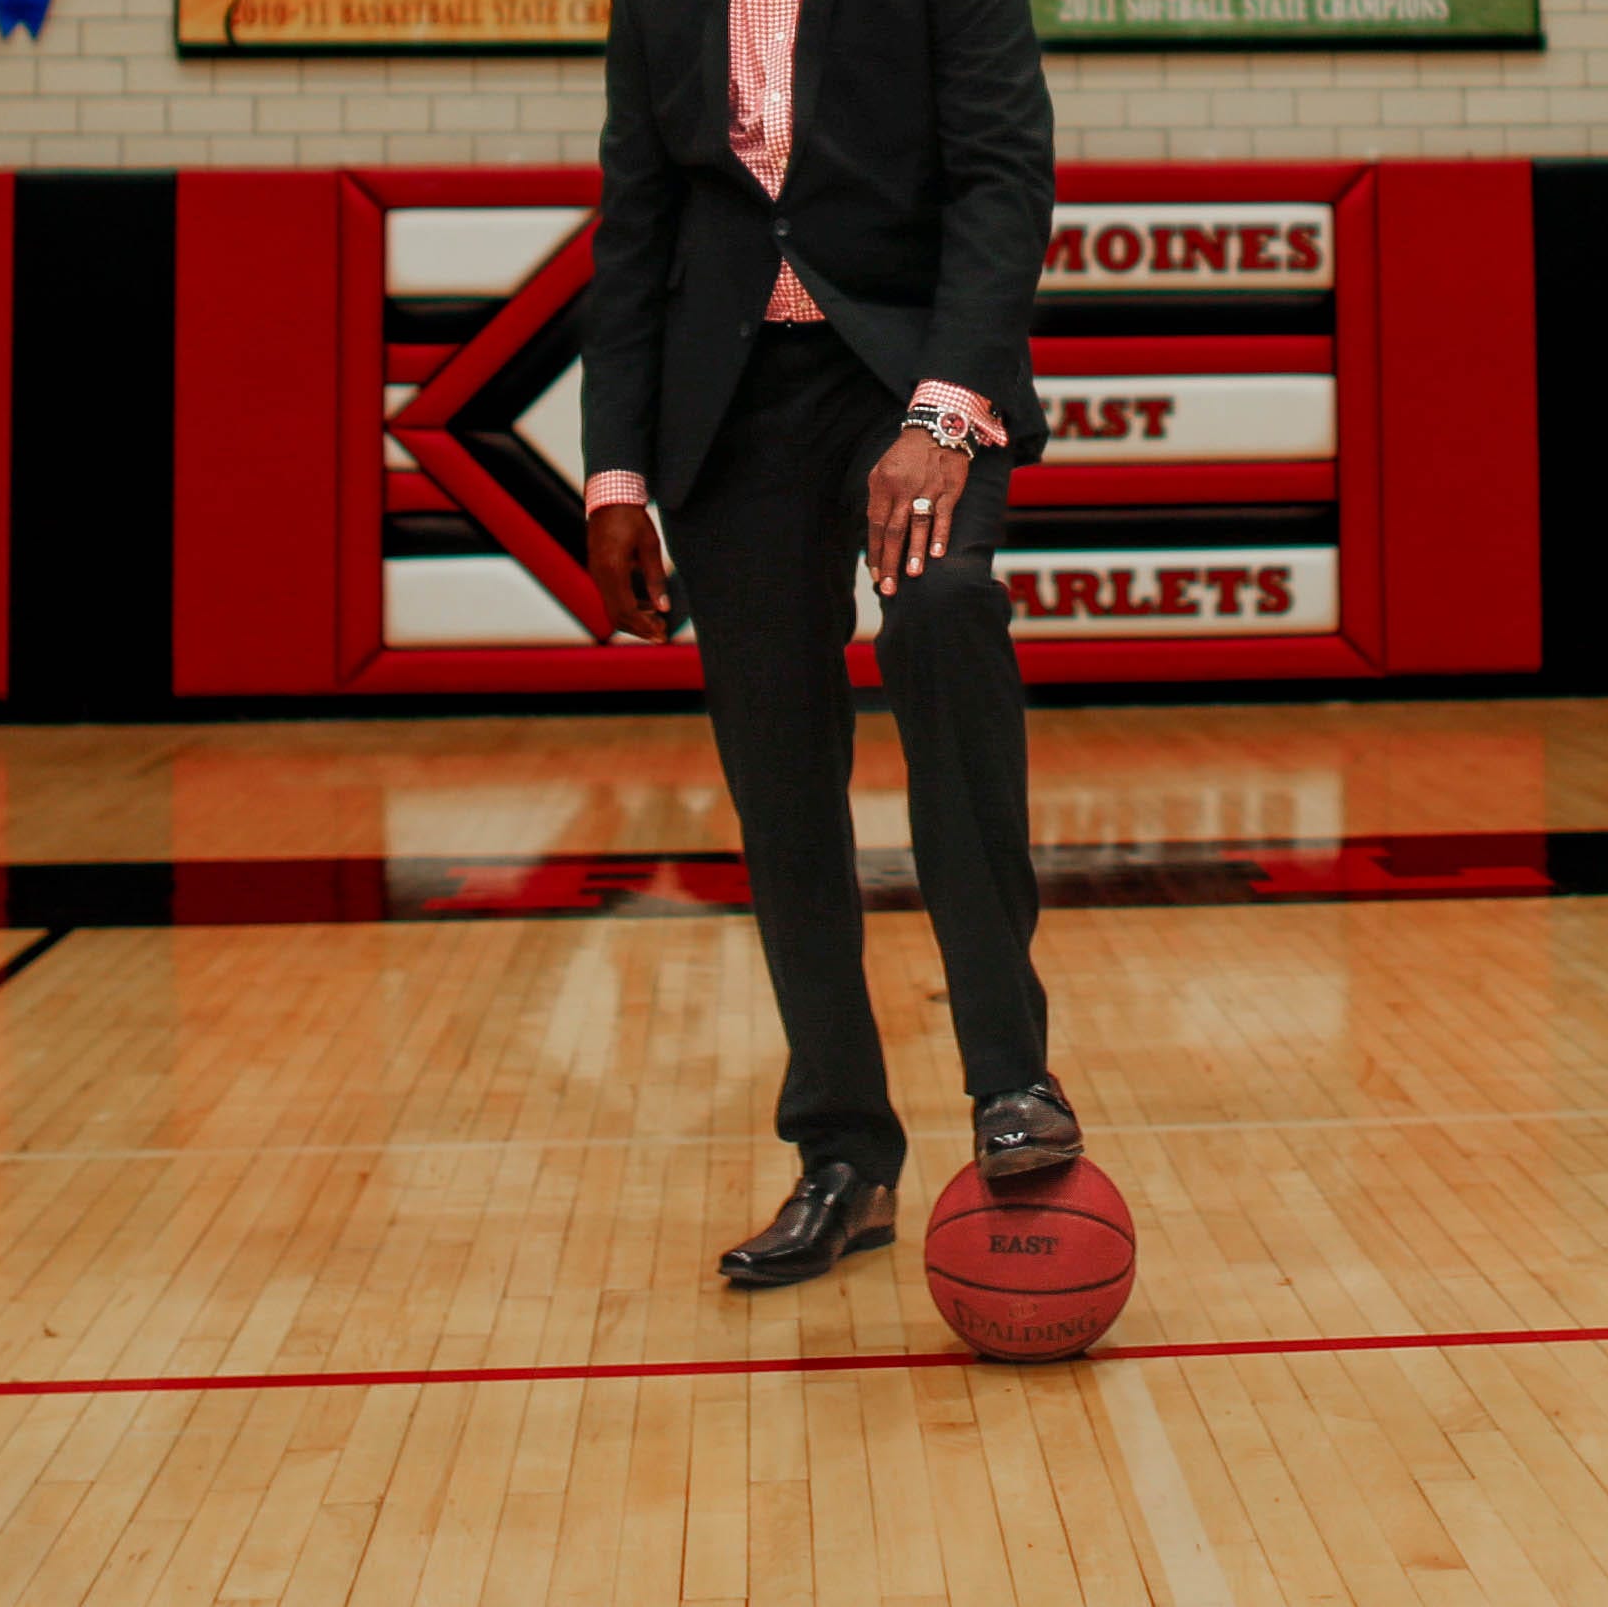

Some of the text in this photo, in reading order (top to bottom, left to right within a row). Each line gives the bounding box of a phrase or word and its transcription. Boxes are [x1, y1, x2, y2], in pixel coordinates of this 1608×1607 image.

[1040, 399, 1173, 440] AST
[988, 1235, 1059, 1255] EAST
[953, 1299, 1098, 1342] SPALDING
